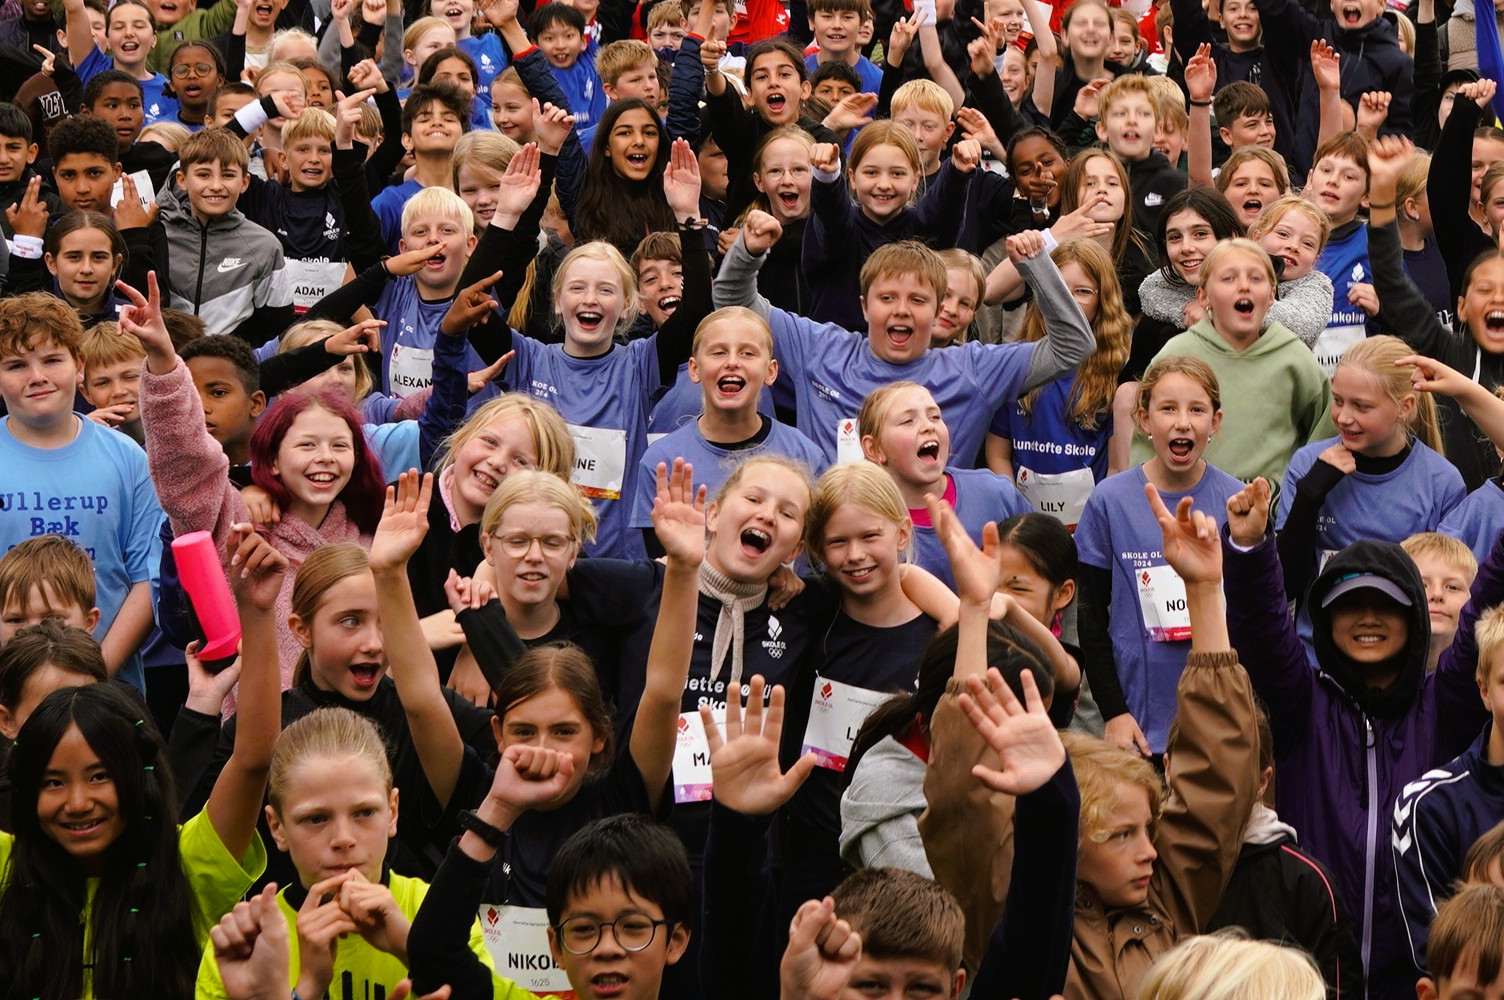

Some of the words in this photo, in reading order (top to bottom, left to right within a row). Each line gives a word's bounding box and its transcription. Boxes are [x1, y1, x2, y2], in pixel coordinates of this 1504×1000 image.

[222, 257, 241, 266] NIKE
[294, 286, 325, 297] ADAM
[548, 385, 558, 395] OL
[829, 389, 841, 399] OL
[1064, 442, 1096, 456] Skole
[0, 491, 108, 514] Ullerup
[1040, 501, 1066, 513] LILY
[30, 515, 80, 536] Bæk
[1122, 551, 1148, 560] SKOLE
[1150, 551, 1162, 559] OL
[1133, 559, 1152, 567] 2024
[761, 640, 781, 649] SKOLE
[530, 978, 550, 988] 1625
